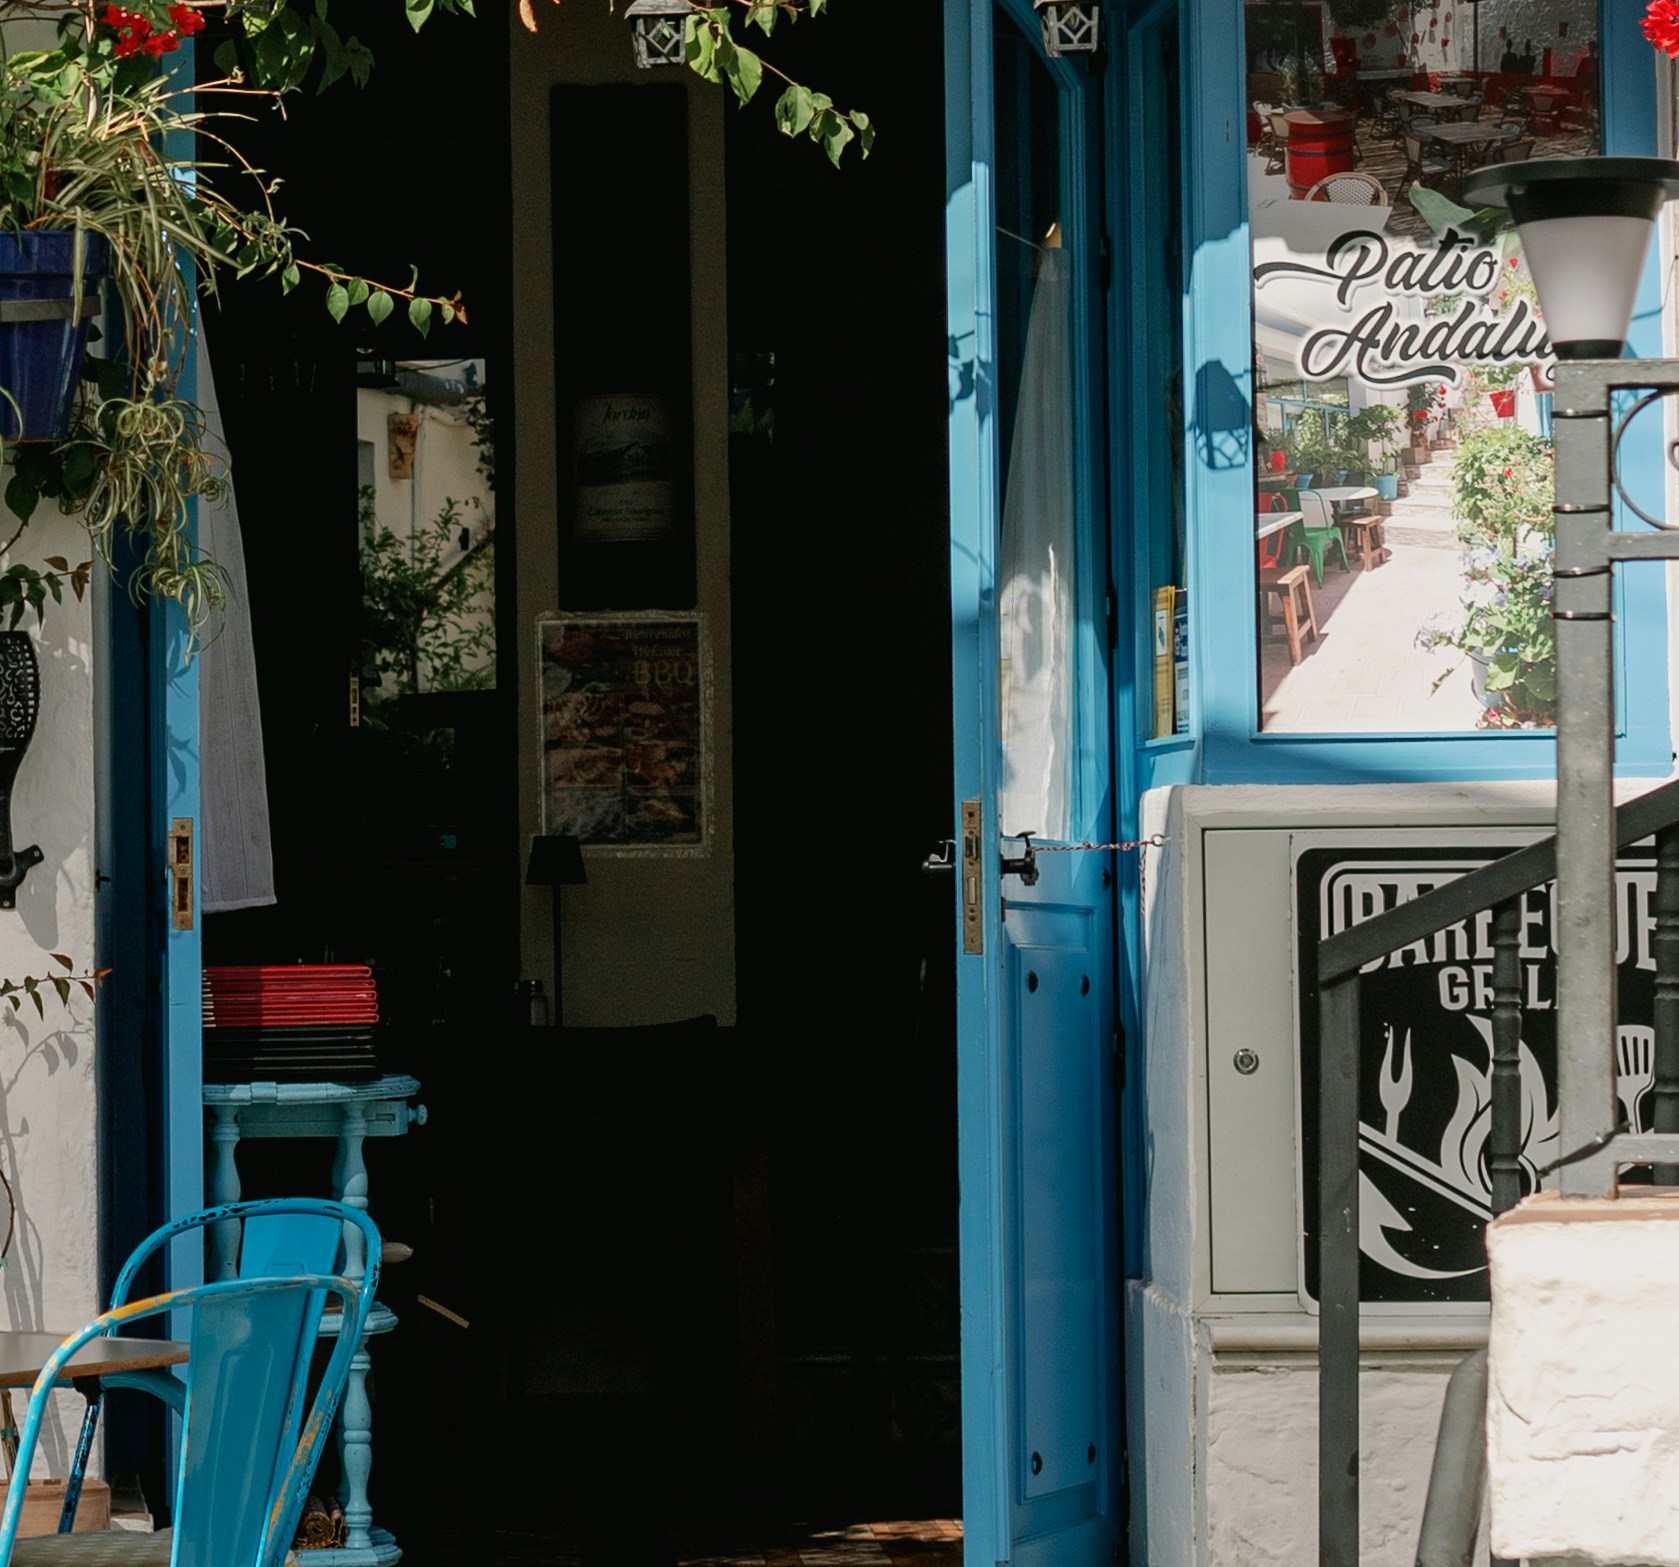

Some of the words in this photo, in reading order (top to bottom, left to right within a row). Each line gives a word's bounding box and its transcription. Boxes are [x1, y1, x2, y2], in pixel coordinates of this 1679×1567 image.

[1253, 228, 1497, 305] Patio
[1302, 299, 1554, 384] Andalu
[1438, 965, 1559, 1011] GRL
